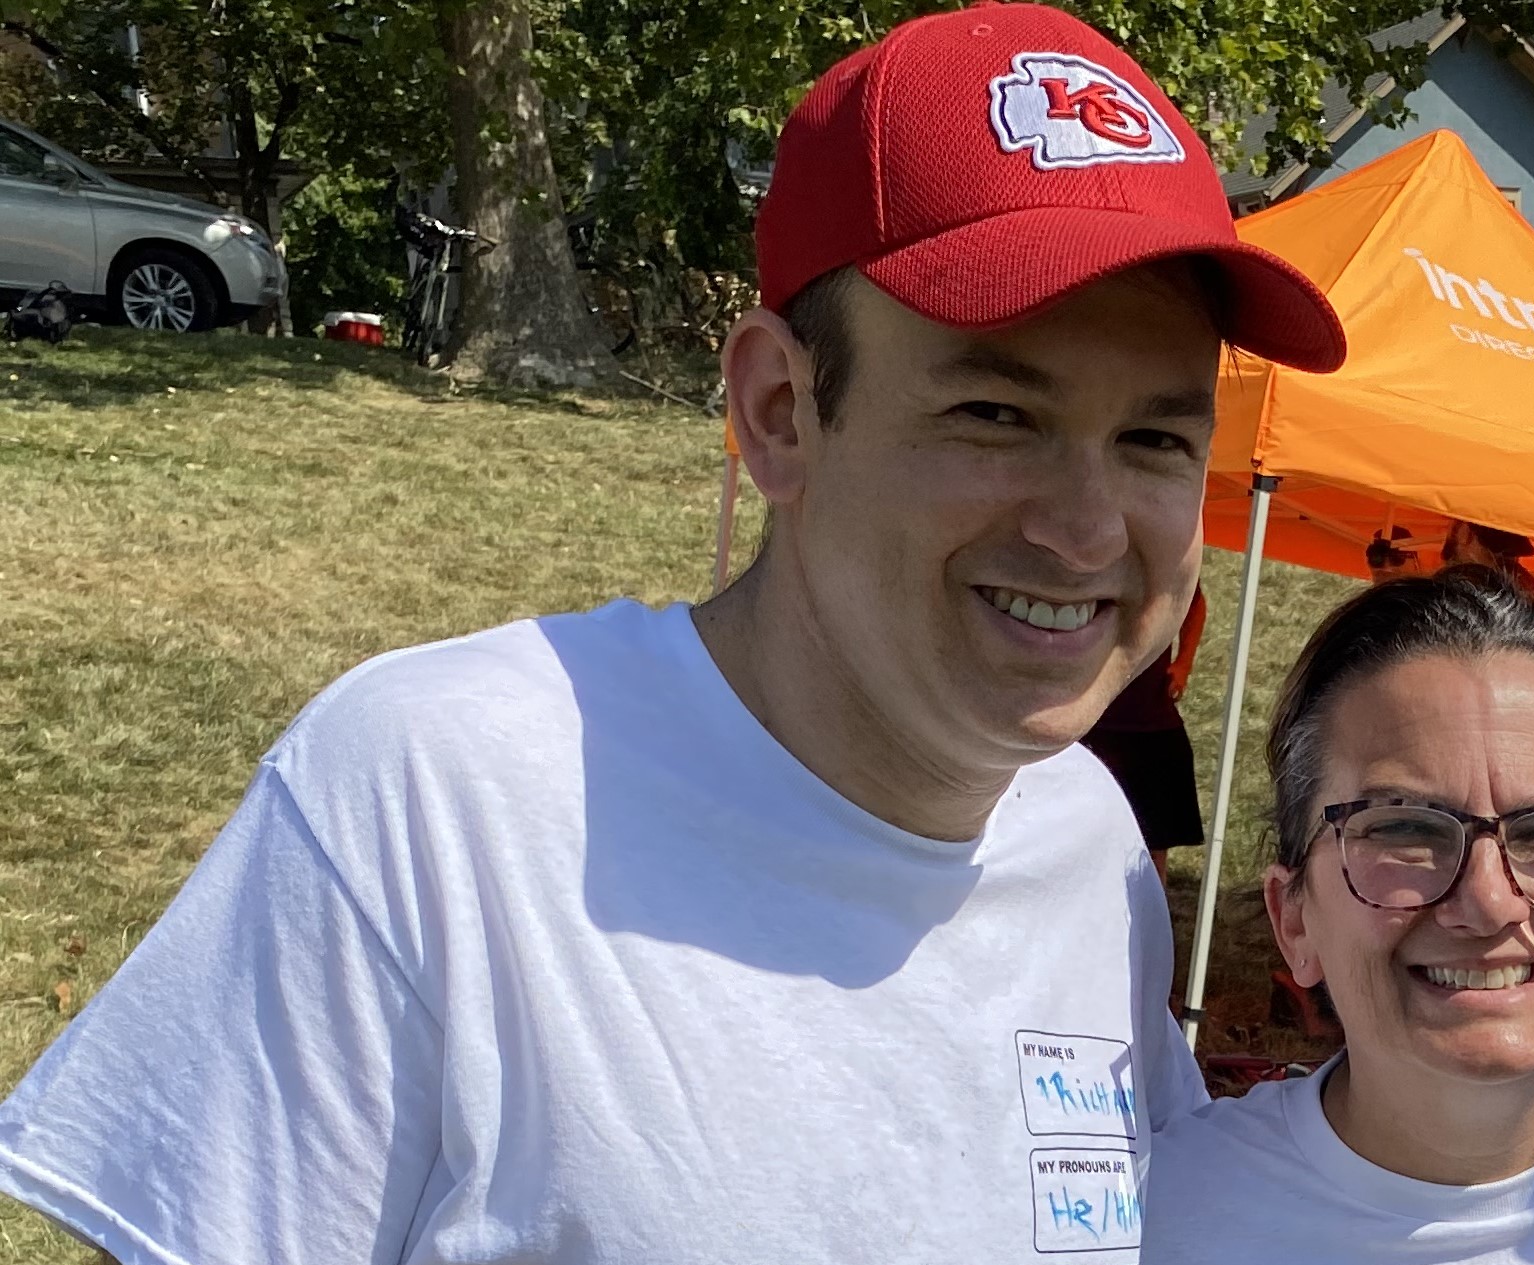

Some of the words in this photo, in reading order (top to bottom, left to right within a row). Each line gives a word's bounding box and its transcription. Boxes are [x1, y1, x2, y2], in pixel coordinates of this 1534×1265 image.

[1039, 78, 1152, 148] KC
[1023, 1043, 1036, 1056] MY
[1038, 1045, 1064, 1059] NAME
[1065, 1048, 1075, 1060] IS
[1037, 1161, 1055, 1174] MY
[1059, 1160, 1111, 1174] PRONOUNS
